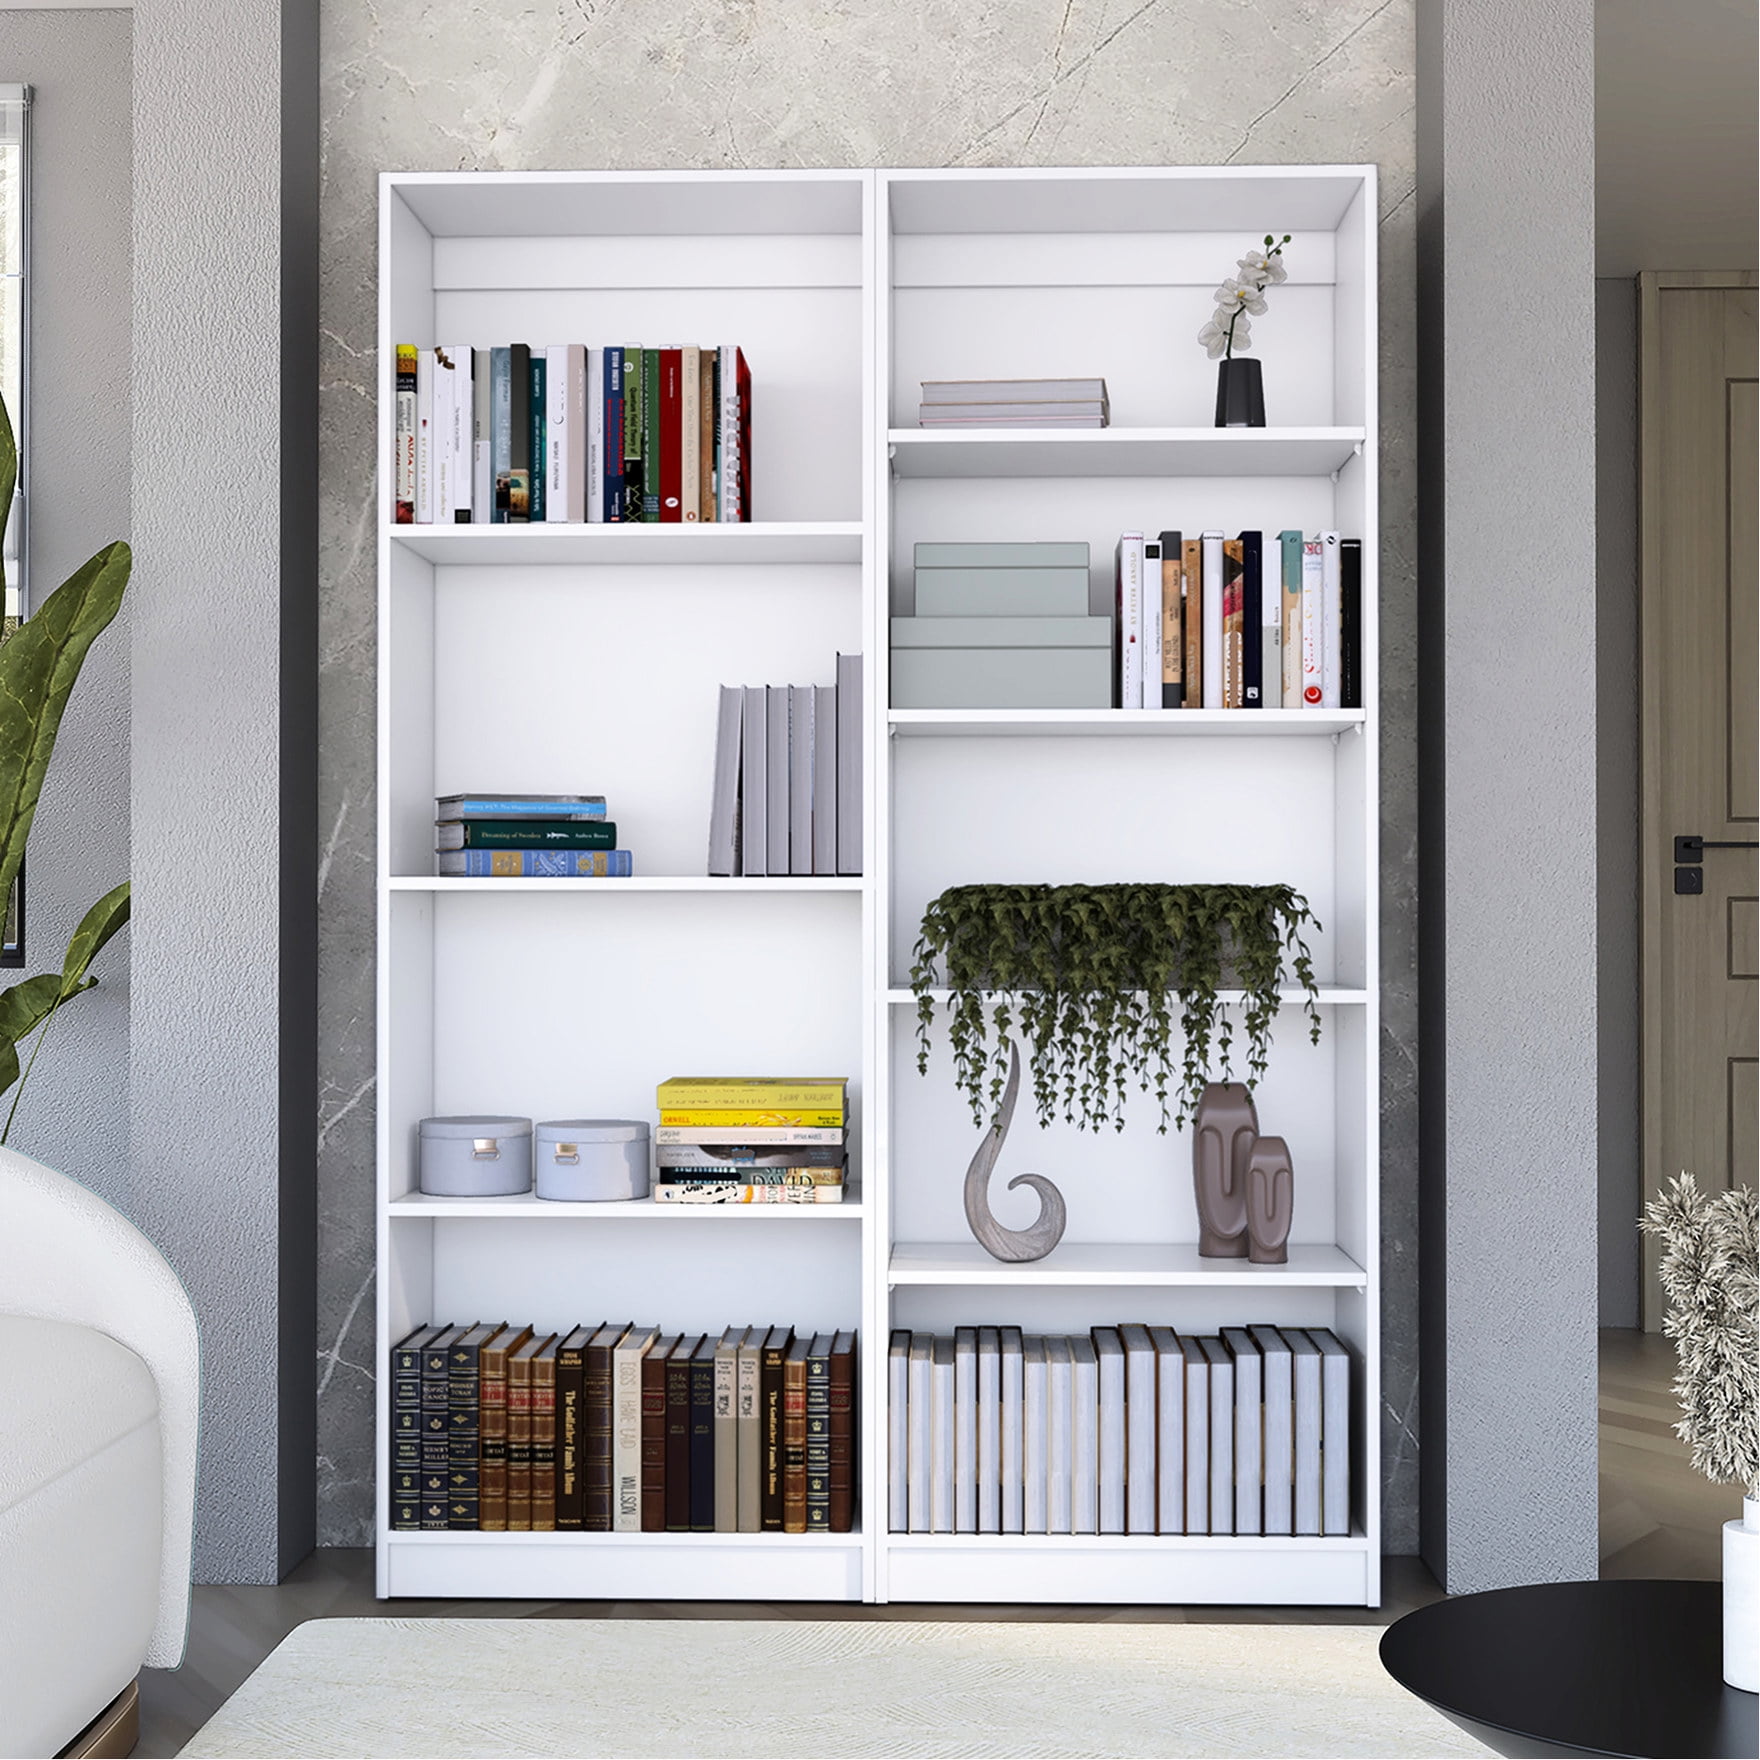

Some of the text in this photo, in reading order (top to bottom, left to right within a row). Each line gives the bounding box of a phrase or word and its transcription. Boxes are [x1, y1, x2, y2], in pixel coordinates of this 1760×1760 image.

[629, 387, 638, 412] Quantum
[630, 414, 638, 427] Field
[629, 429, 638, 447] Theory
[619, 1361, 637, 1385] EGGS
[619, 1399, 637, 1424] HAVE
[564, 1391, 577, 1495] The Godfather Family Album
[619, 1428, 636, 1449] LAID
[769, 1391, 778, 1495] The Godfather Family Album
[620, 1476, 637, 1515] WILLSON
